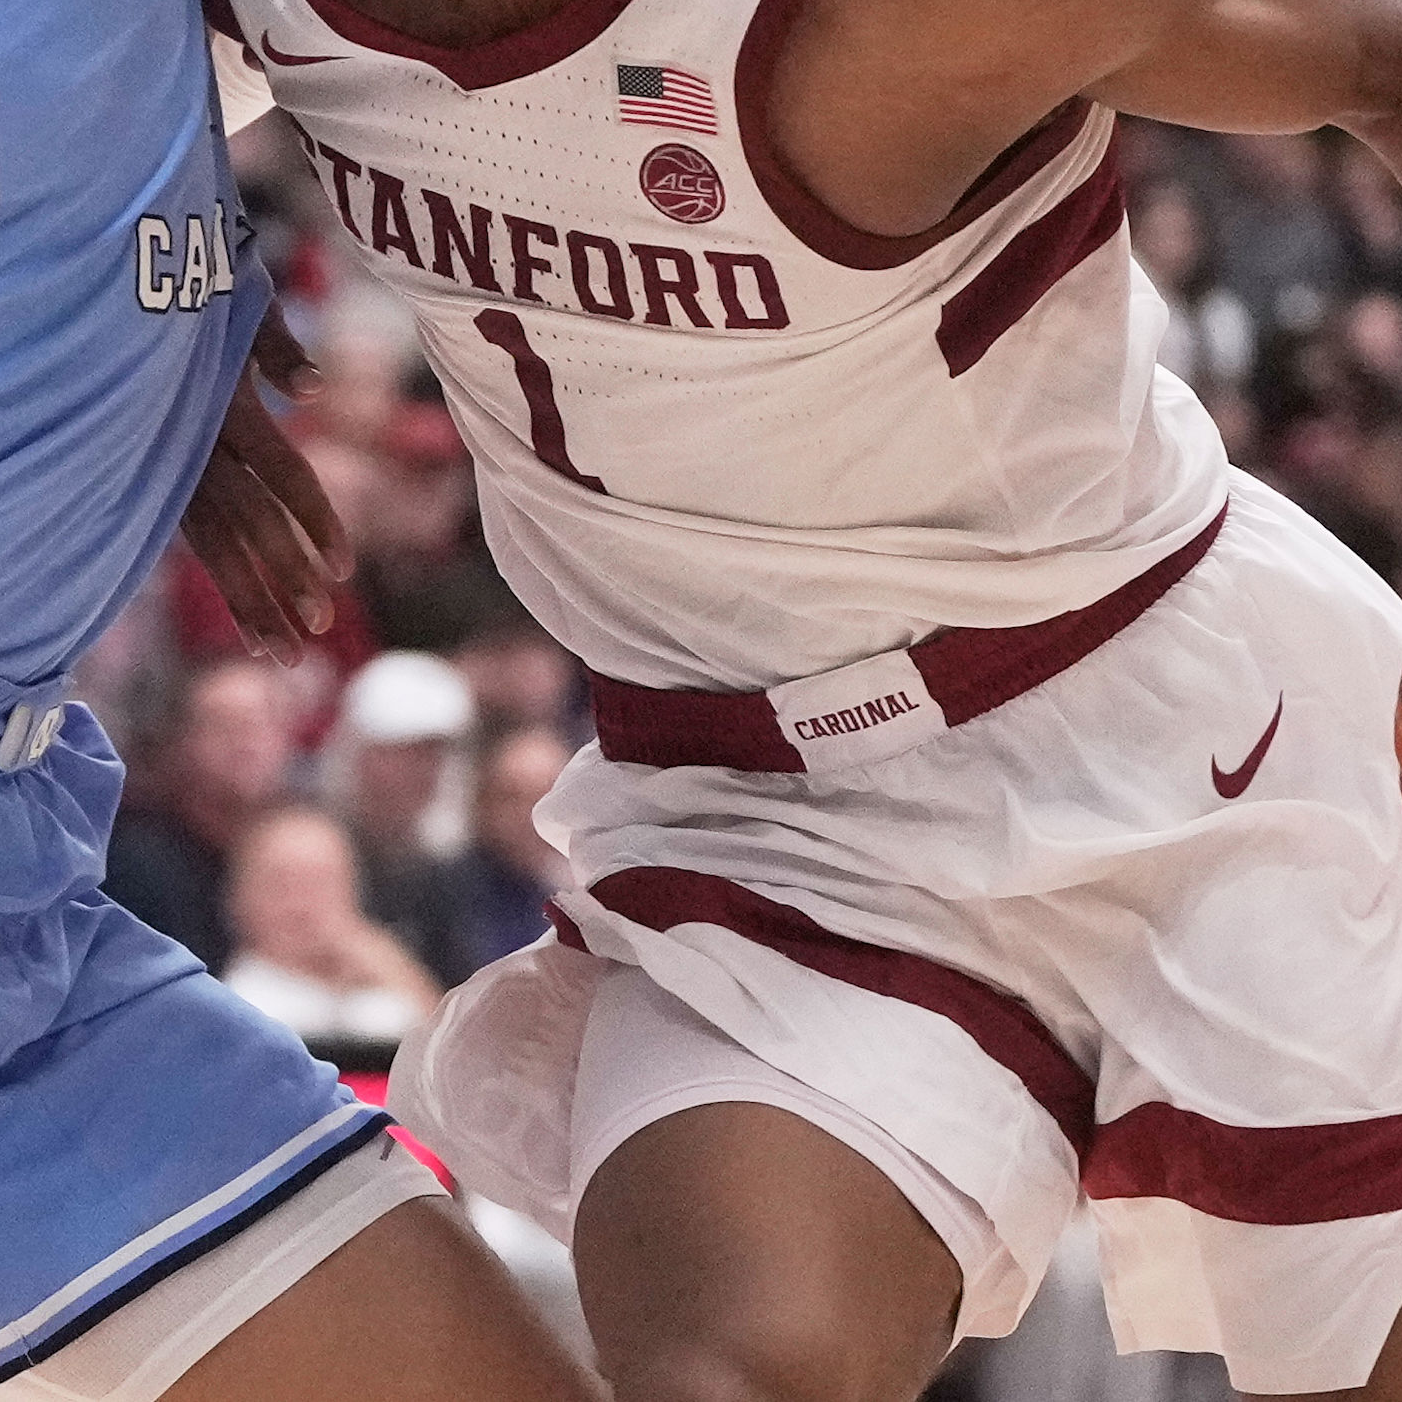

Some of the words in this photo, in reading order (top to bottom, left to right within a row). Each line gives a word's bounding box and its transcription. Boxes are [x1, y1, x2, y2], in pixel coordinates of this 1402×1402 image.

[654, 172, 715, 193] ACC
[473, 307, 608, 495] 1
[795, 690, 920, 741] CARDINAL
